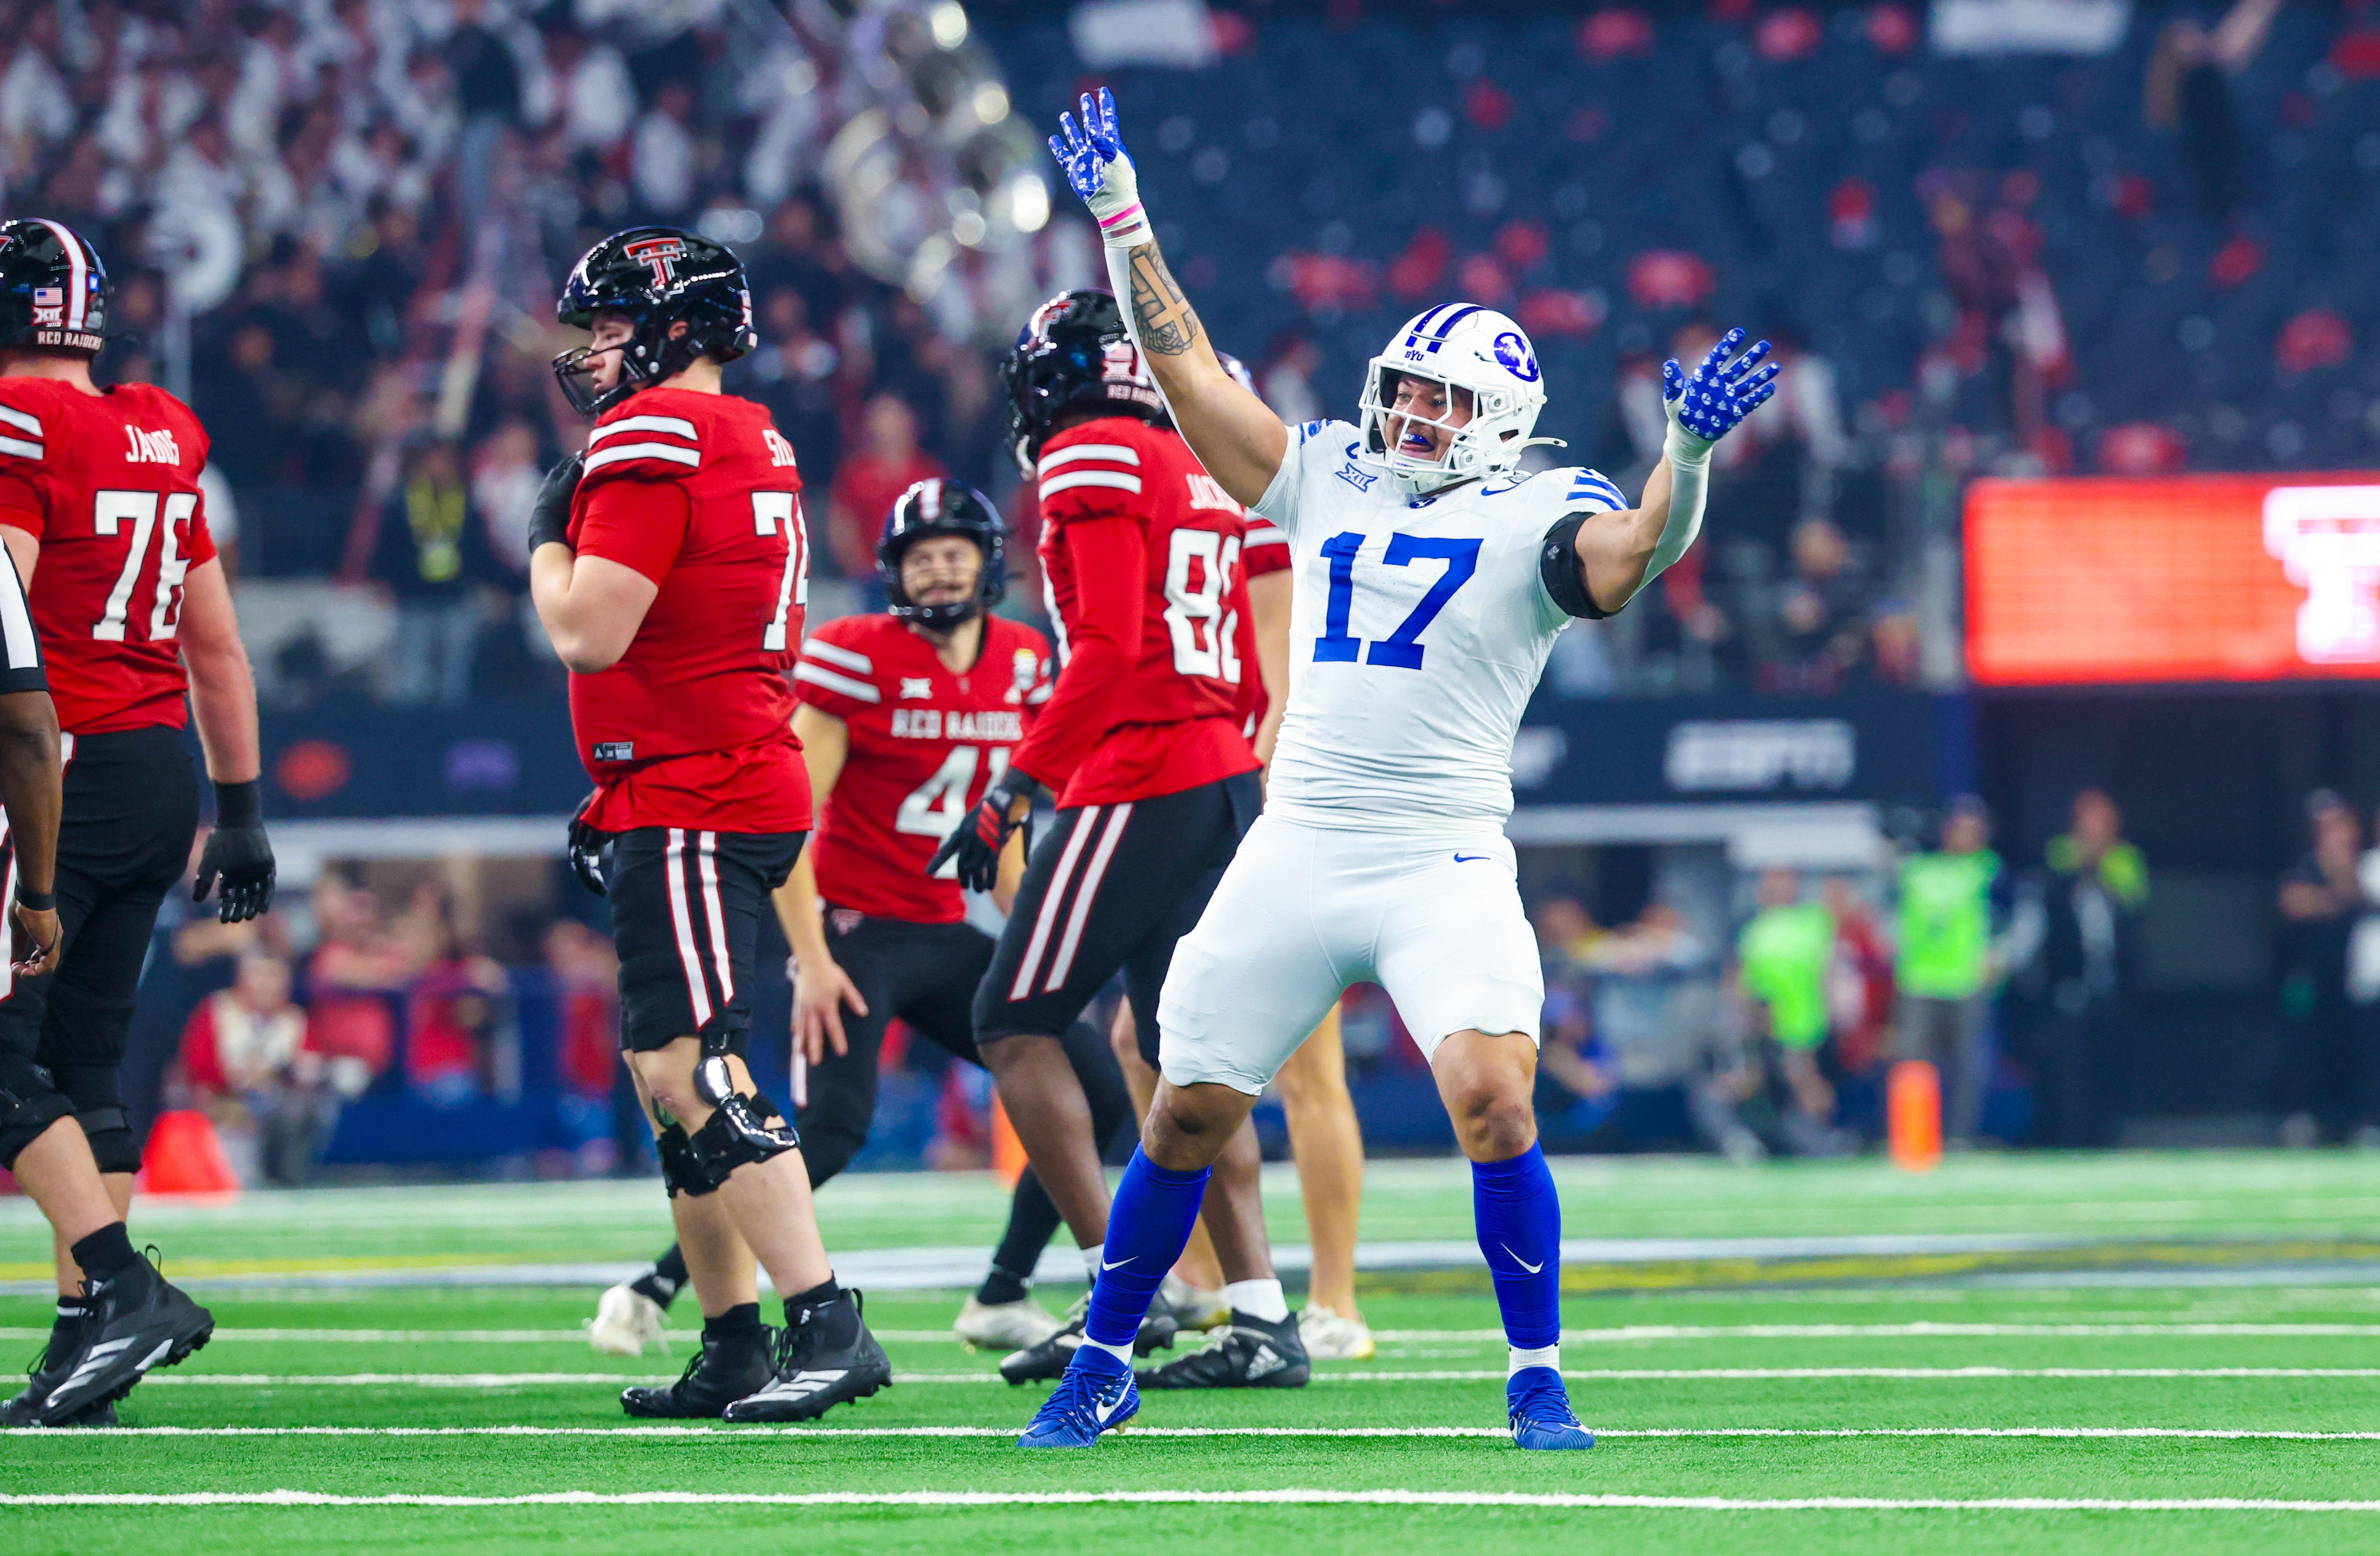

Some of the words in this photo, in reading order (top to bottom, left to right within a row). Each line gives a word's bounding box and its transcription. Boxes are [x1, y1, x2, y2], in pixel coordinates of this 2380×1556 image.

[38, 331, 62, 345] RED
[64, 332, 103, 350] RAIDERS
[1405, 350, 1425, 361] BYU
[92, 490, 198, 642] 76
[1313, 531, 1484, 670] 17
[891, 708, 942, 739] RED
